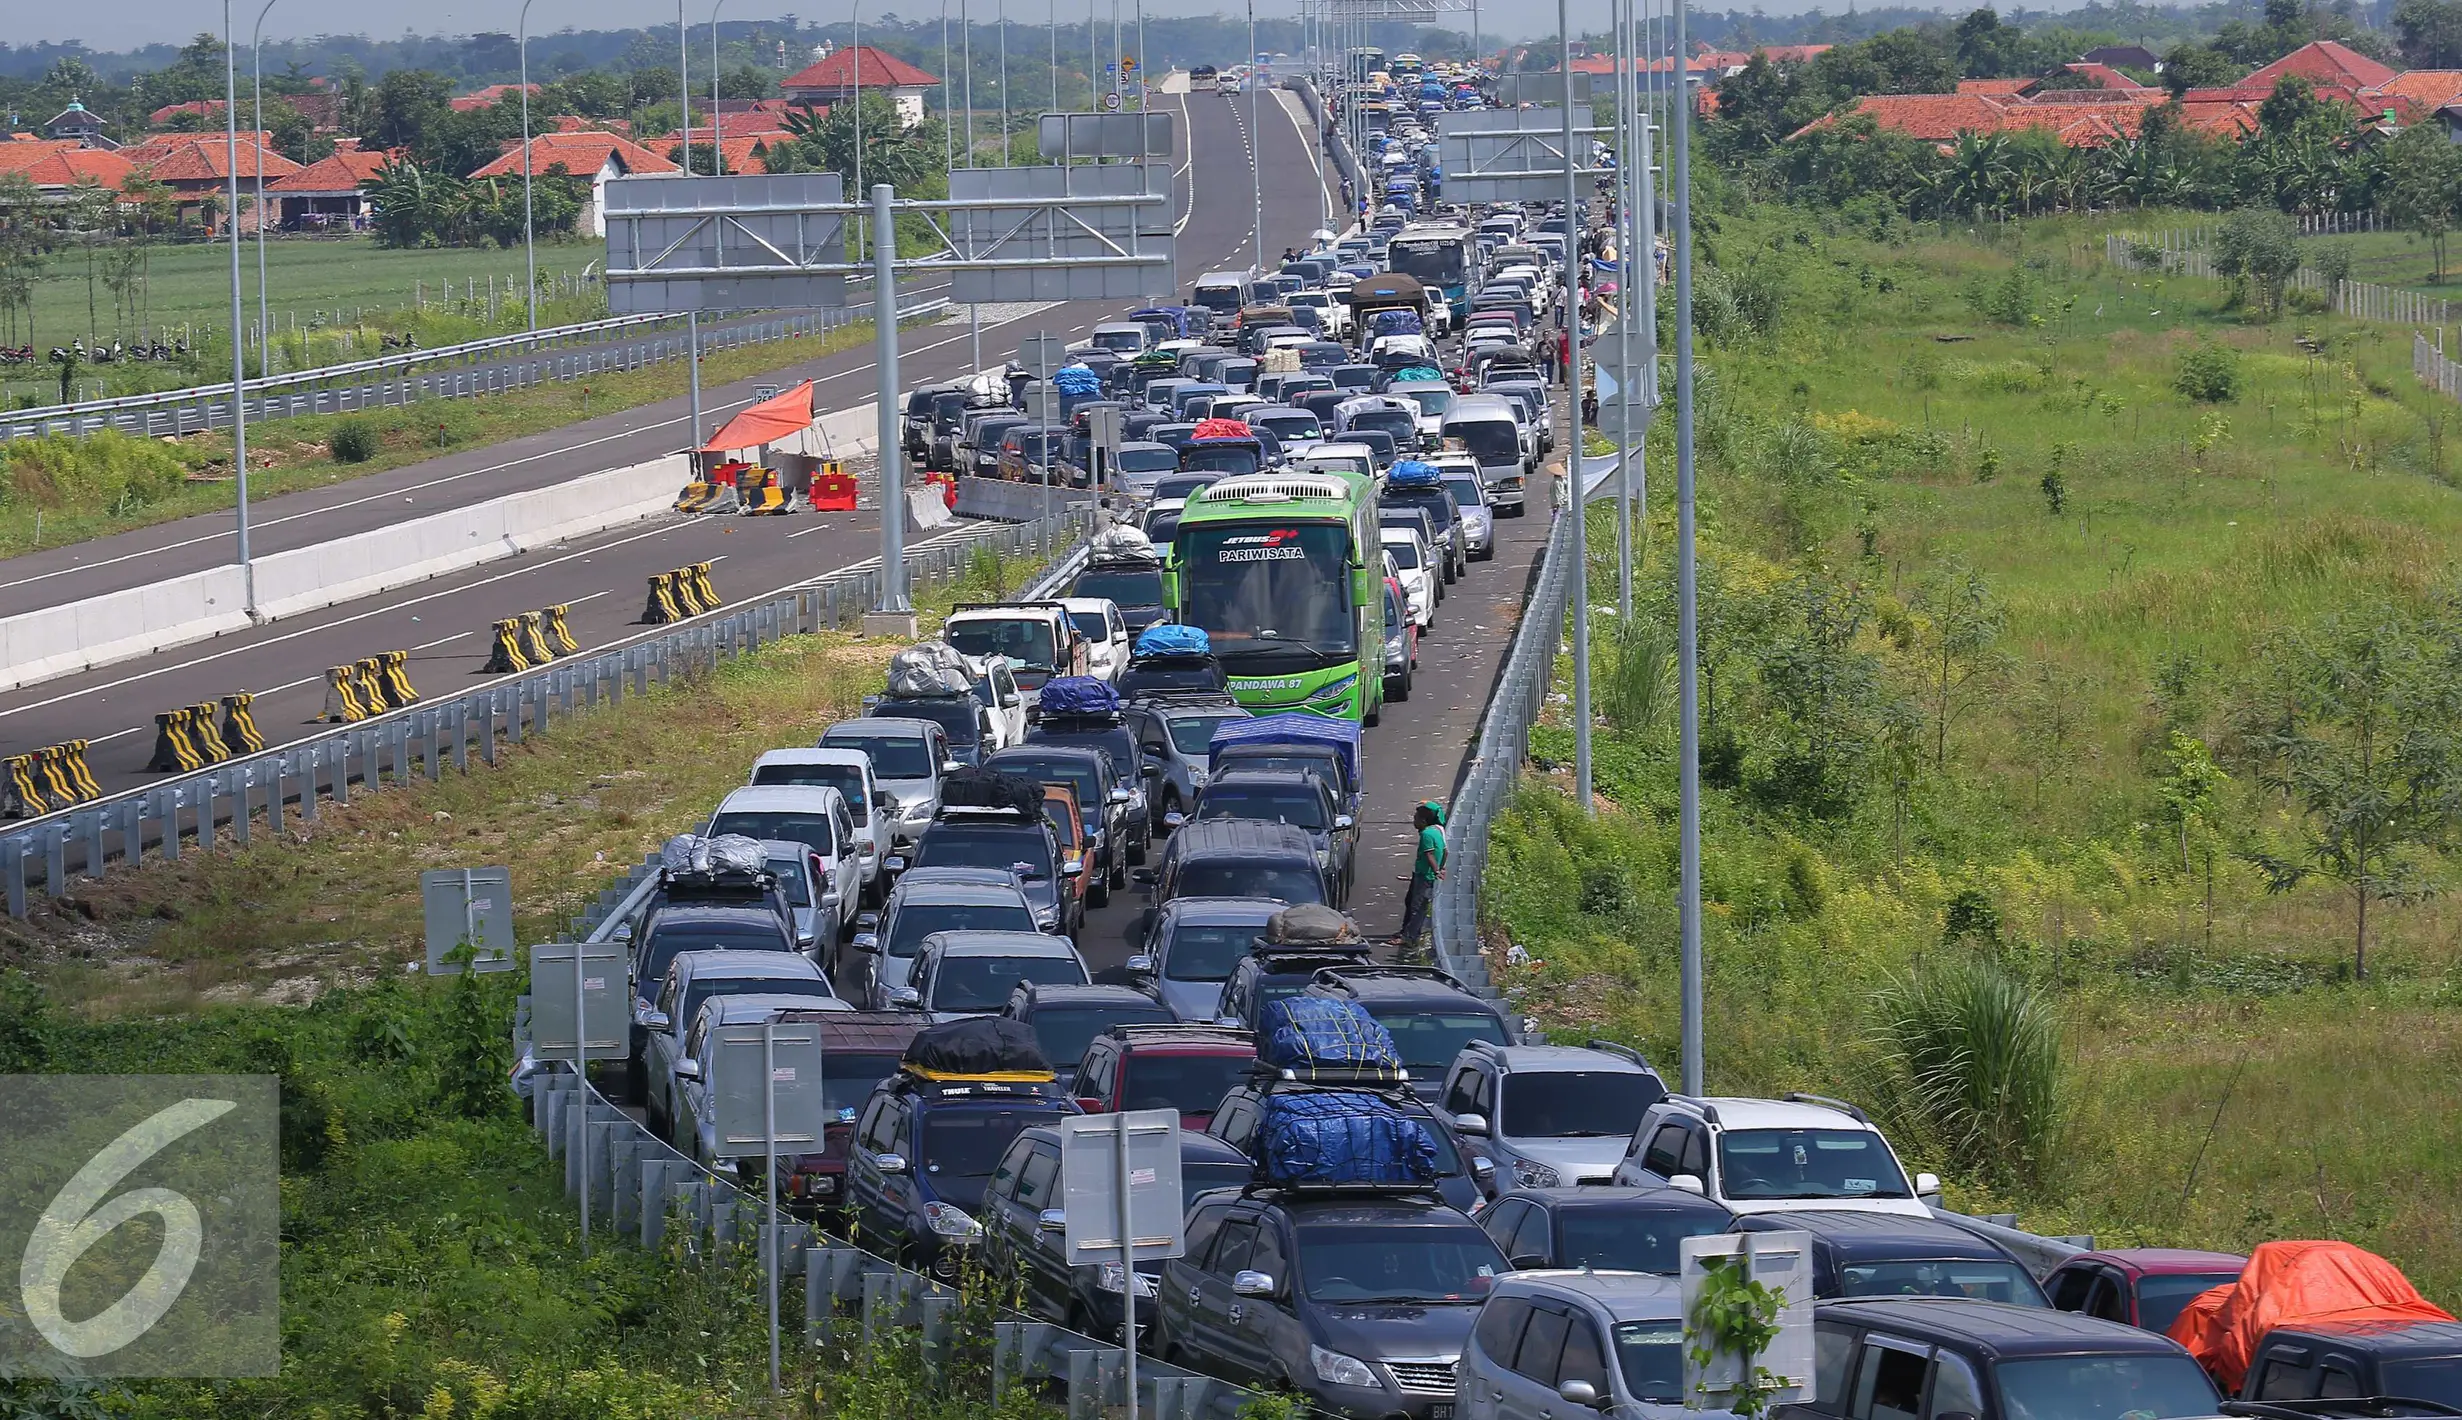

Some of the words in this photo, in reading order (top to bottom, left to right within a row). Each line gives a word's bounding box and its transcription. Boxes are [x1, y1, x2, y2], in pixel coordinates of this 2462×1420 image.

[1222, 536, 1270, 544] JETBUS
[1219, 547, 1305, 562] PARIWISATA
[1230, 680, 1285, 690] PANDAWA
[1288, 679, 1302, 688] 87
[942, 1088, 972, 1096] THULE
[1433, 1405, 1447, 1419] BH
